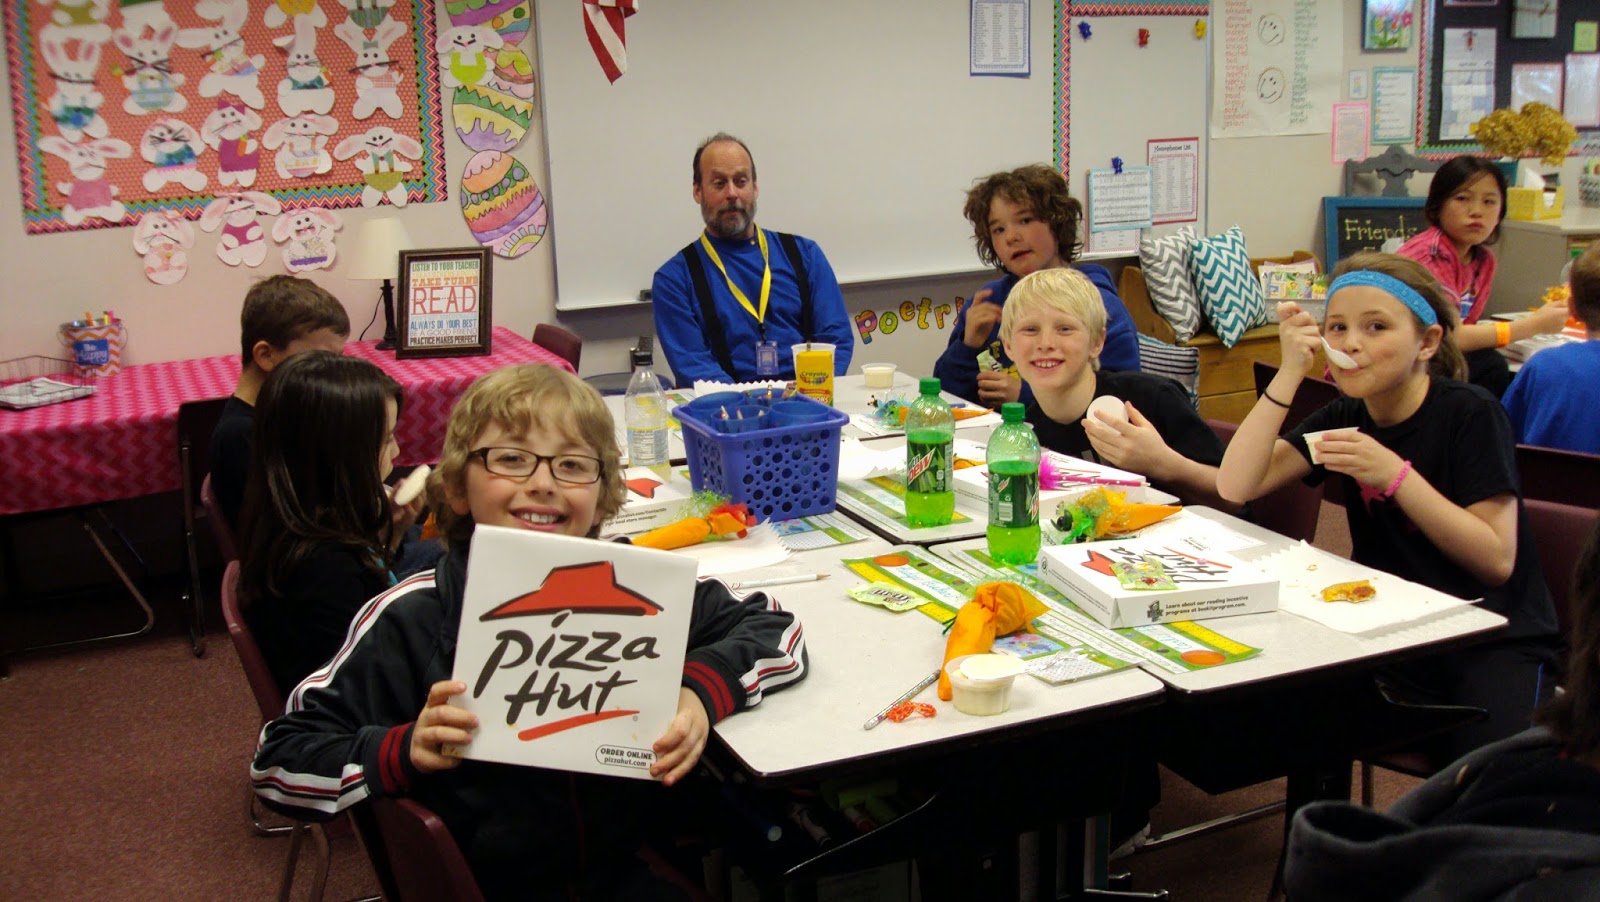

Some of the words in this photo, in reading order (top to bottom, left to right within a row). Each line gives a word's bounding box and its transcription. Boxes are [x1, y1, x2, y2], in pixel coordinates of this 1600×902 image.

[1344, 215, 1417, 241] Friends
[412, 262, 430, 272] LISTEN
[431, 262, 438, 271] TO
[439, 261, 454, 271] YOUR
[455, 260, 479, 270] TEACHER
[412, 277, 442, 287] TAKE
[443, 276, 479, 286] TURNS
[412, 285, 477, 315] READ
[410, 320, 436, 330] ALWAYS
[437, 320, 444, 329] DO
[446, 319, 460, 329] YOUR
[462, 318, 477, 328] BEST
[453, 327, 477, 335] FRIEND
[410, 337, 435, 345] PRACTICE
[436, 336, 454, 344] MAKES
[454, 335, 477, 344] PERFECT
[83, 343, 97, 351] Be
[1207, 597, 1225, 605] reading
[473, 610, 661, 699] Pizza
[504, 669, 638, 726] Hut
[600, 748, 626, 758] ORDER
[627, 750, 653, 760] ONLINE
[604, 755, 647, 768] pizzahut.com
